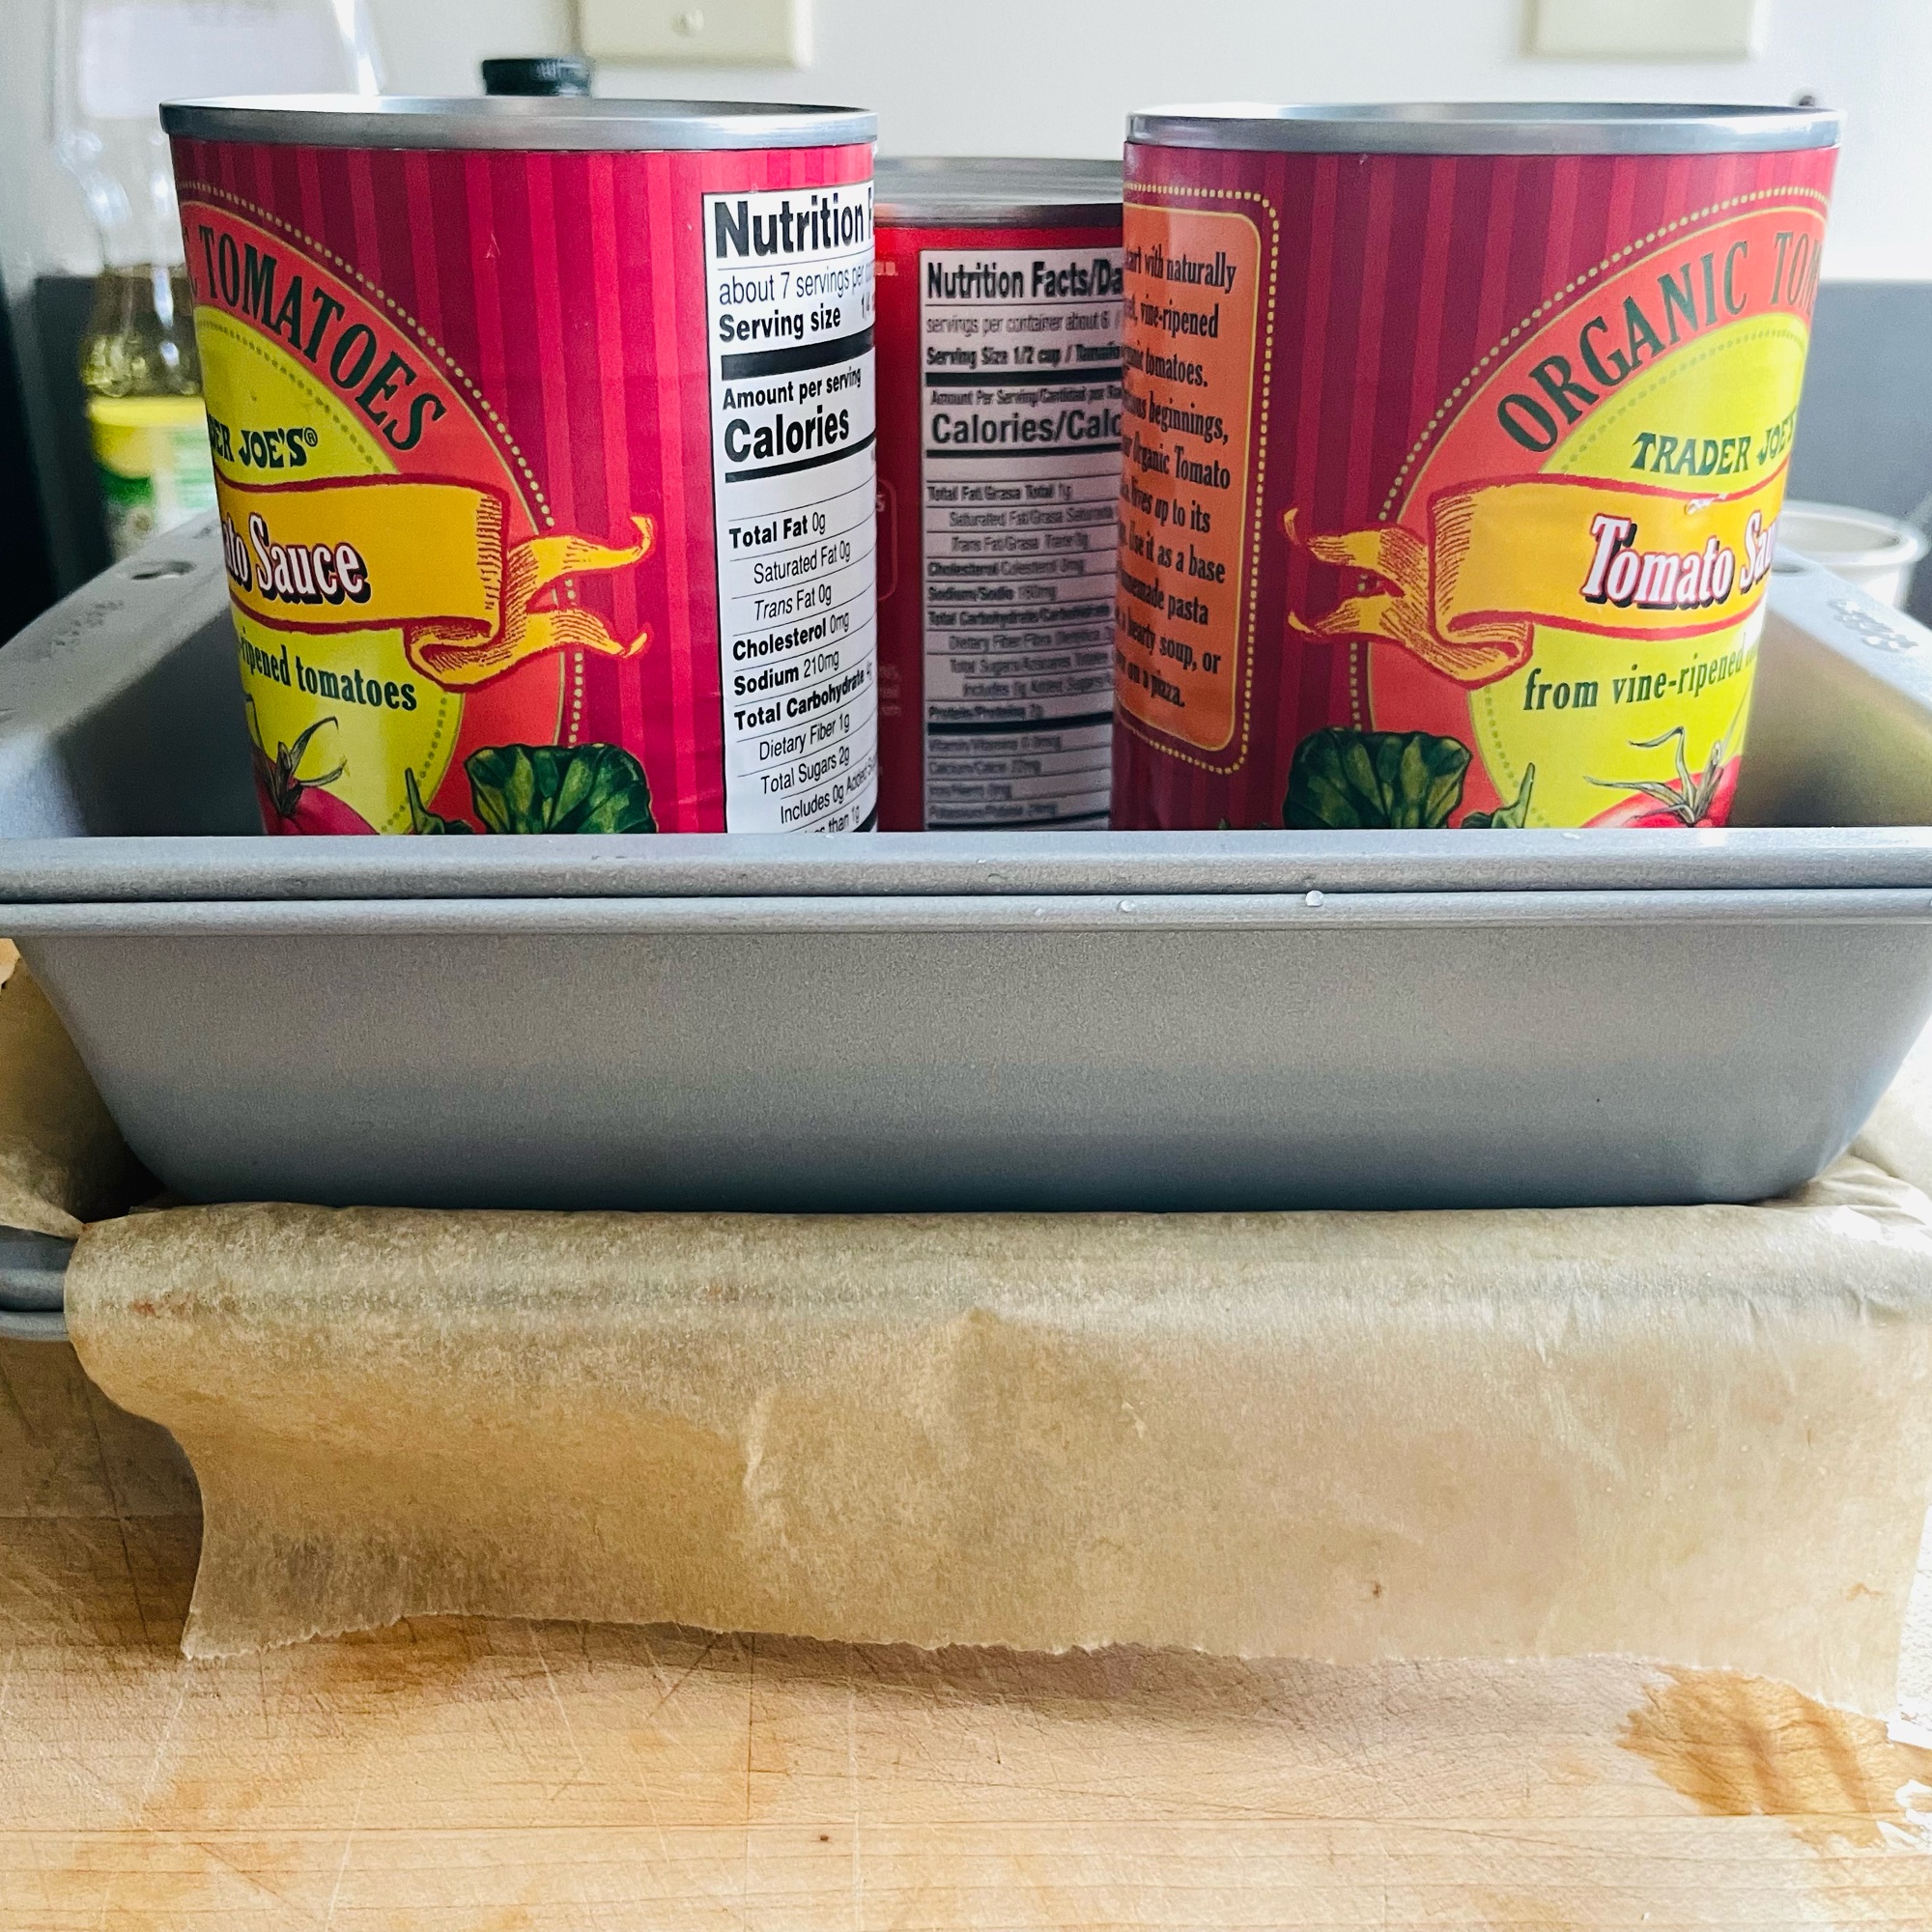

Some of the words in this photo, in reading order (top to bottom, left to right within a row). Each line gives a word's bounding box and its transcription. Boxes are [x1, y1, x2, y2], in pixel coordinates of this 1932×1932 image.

[714, 192, 864, 259] Nutrition
[719, 274, 775, 305] about
[781, 271, 790, 299] 7
[796, 266, 849, 298] servings
[852, 265, 864, 296] per
[927, 262, 1024, 298] Nutrition
[1145, 243, 1163, 279] with
[1167, 251, 1237, 294] naturally
[198, 224, 447, 451] TOMATOES
[719, 309, 804, 342] Serving
[810, 302, 841, 331] size
[927, 314, 979, 337] servings
[982, 318, 1004, 337] per
[1141, 294, 1219, 338] vine-ripened
[927, 347, 978, 369] Serving
[1146, 347, 1208, 386] tomatoes.
[1496, 240, 1748, 453] ORGANIC
[723, 381, 794, 411] Amount
[799, 379, 822, 405] per
[826, 366, 862, 394] serving
[724, 405, 849, 462] Calories
[1150, 390, 1229, 445] beginnings,
[1174, 444, 1231, 490] Tomato
[1630, 432, 1751, 475] TRADER
[728, 522, 778, 549] Total
[783, 515, 808, 539] Fat
[812, 512, 826, 534] 0g
[1155, 498, 1169, 526] up
[1173, 498, 1185, 527] to
[1190, 499, 1210, 533] its
[249, 512, 372, 605] Sauce
[753, 549, 817, 584] Saturated
[821, 544, 838, 567] Fat
[839, 540, 851, 562] 0g
[1147, 530, 1154, 562] it
[1157, 545, 1172, 569] as
[1176, 552, 1184, 573] a
[1189, 544, 1226, 583] base
[1579, 513, 1735, 611] Tomato
[754, 597, 793, 620] Trans
[796, 587, 815, 611] Fat
[818, 583, 832, 606] 0g
[1168, 594, 1208, 626] pasta
[732, 617, 826, 661] Cholesterol
[830, 612, 849, 633] 0mg
[1160, 636, 1197, 671] soup,
[1203, 651, 1221, 674] or
[296, 655, 417, 711] tomatoes
[734, 667, 799, 696] Sodium
[804, 651, 839, 678] 210mg
[1522, 668, 1599, 711] from
[1612, 631, 1747, 705] vine-ripened
[734, 701, 781, 730] Total
[786, 668, 865, 718] Carbohydrate
[759, 733, 807, 760] Dietary
[810, 720, 837, 745] Fiber
[839, 713, 850, 733] 1g
[760, 767, 795, 794] Total
[799, 754, 837, 781] Sugars
[838, 746, 850, 766] 2g
[781, 792, 830, 824] Includes
[833, 784, 844, 804] 0g
